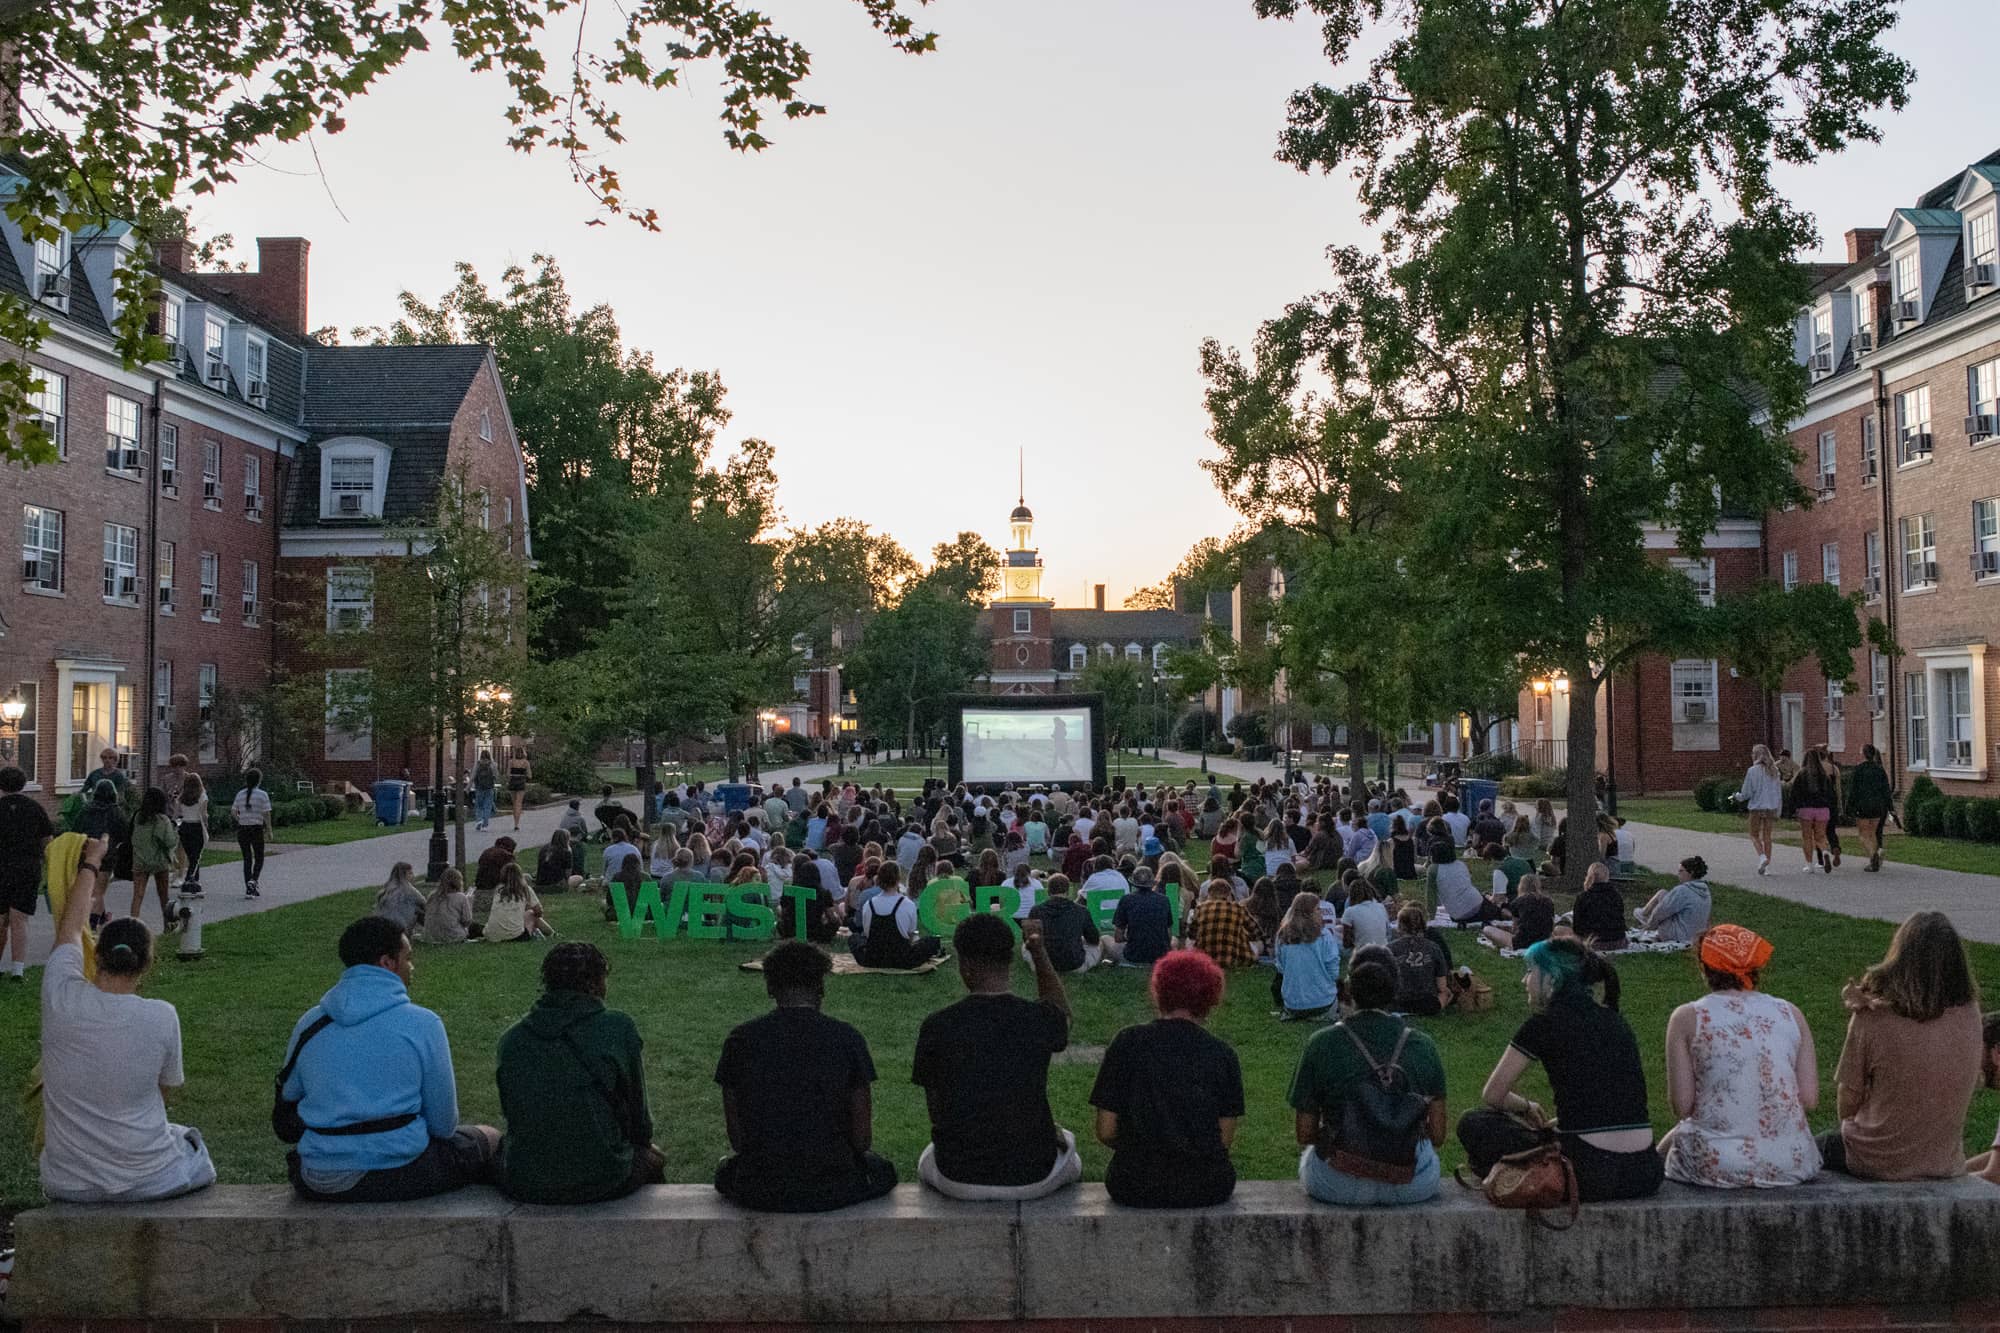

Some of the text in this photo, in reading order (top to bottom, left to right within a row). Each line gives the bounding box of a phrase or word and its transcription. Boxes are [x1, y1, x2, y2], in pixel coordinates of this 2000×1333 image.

[608, 878, 1180, 945] WEST GRE
[1405, 951, 1425, 967] 42
